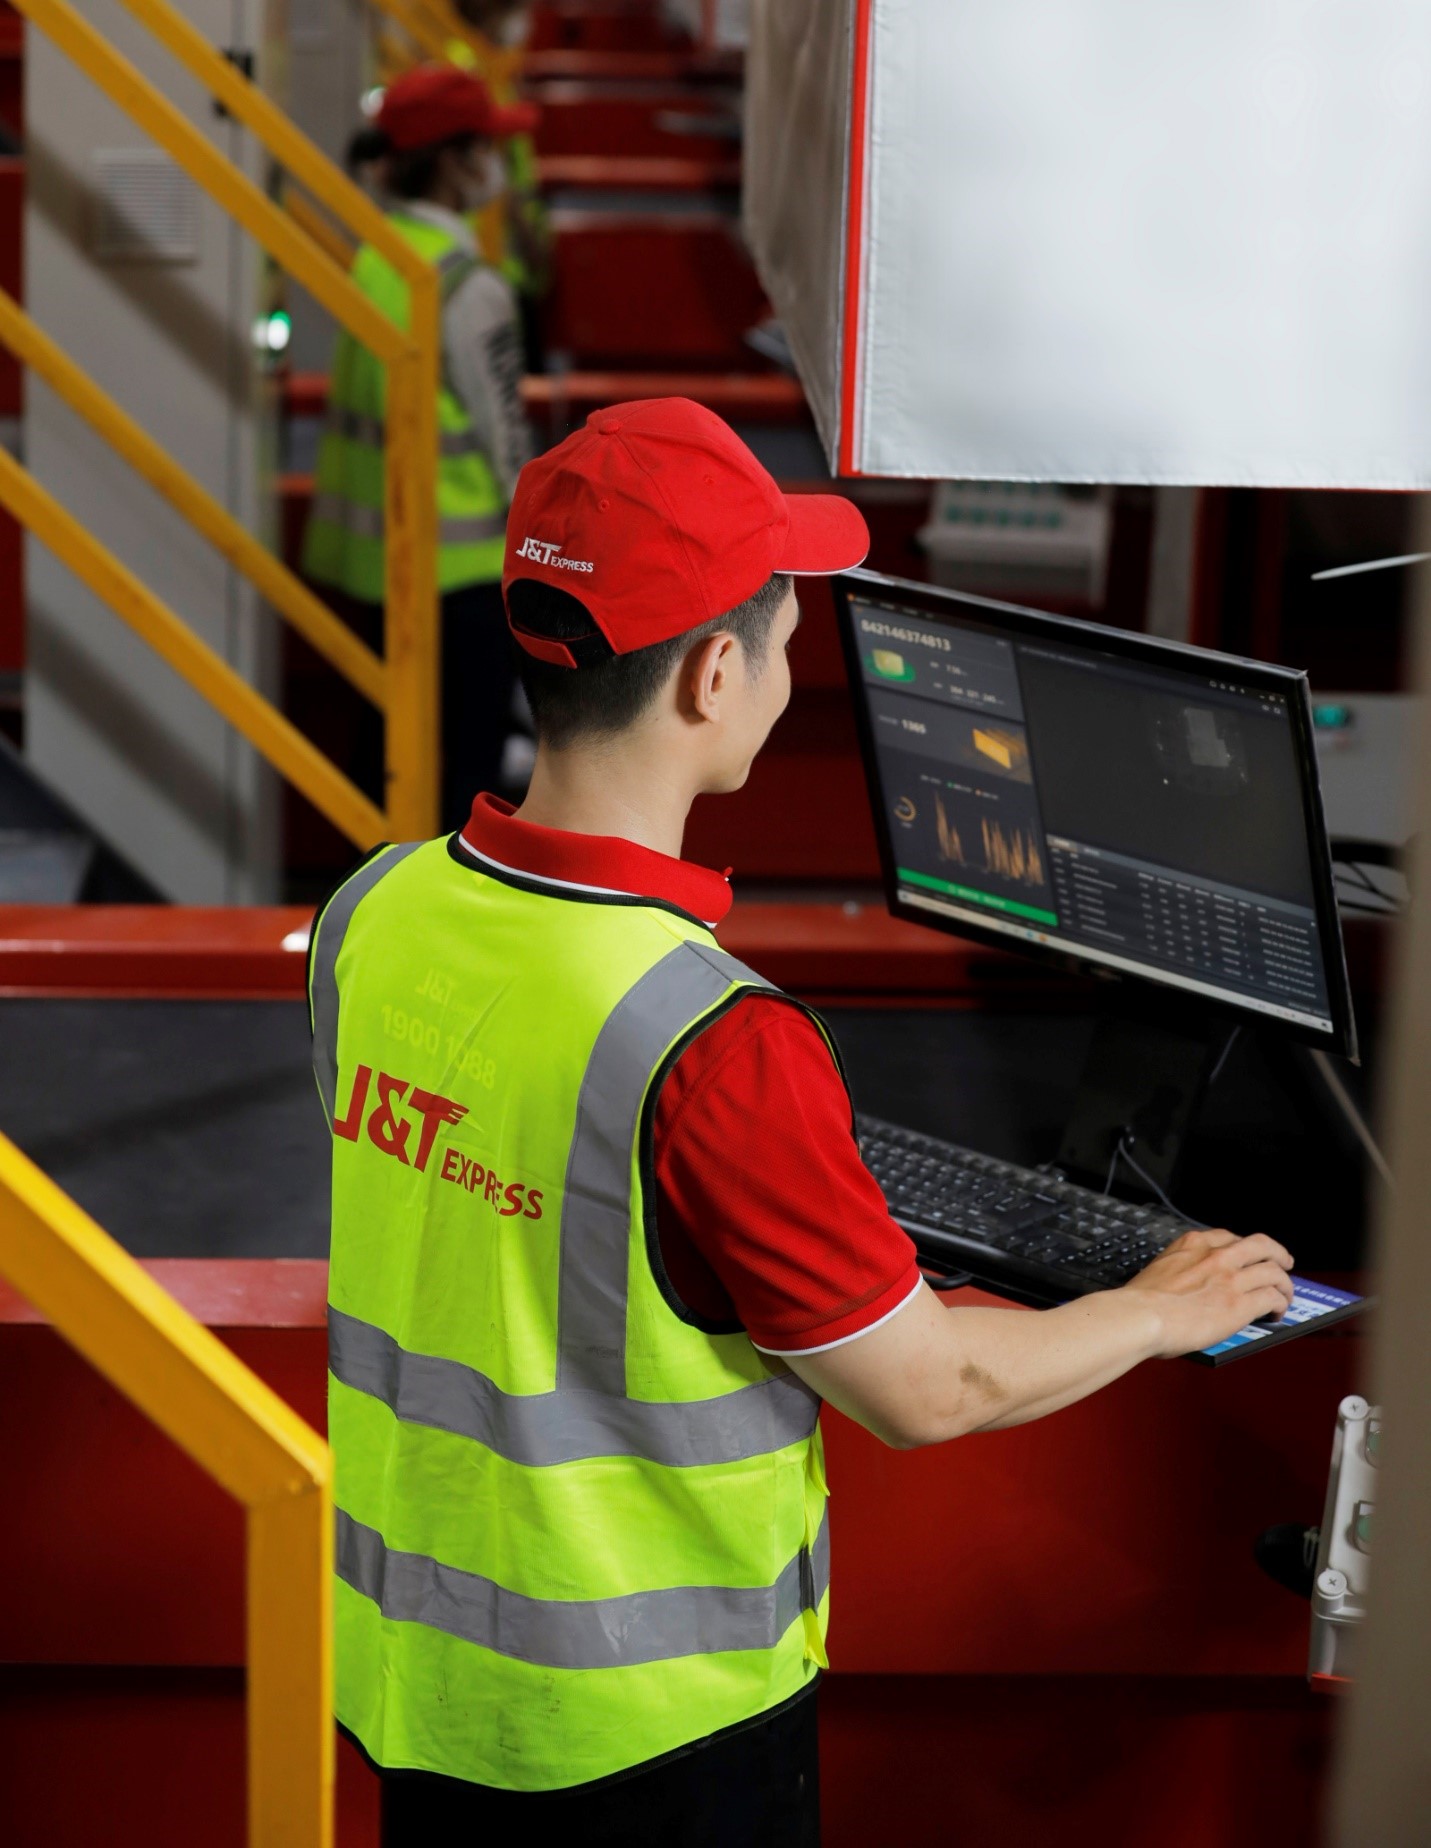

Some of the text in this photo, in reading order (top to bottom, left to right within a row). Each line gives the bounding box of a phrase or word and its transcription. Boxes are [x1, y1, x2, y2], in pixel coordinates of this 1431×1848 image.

[516, 537, 594, 573] J&T EXPRESS
[381, 1004, 440, 1056] 1900
[334, 1064, 470, 1173] J&T
